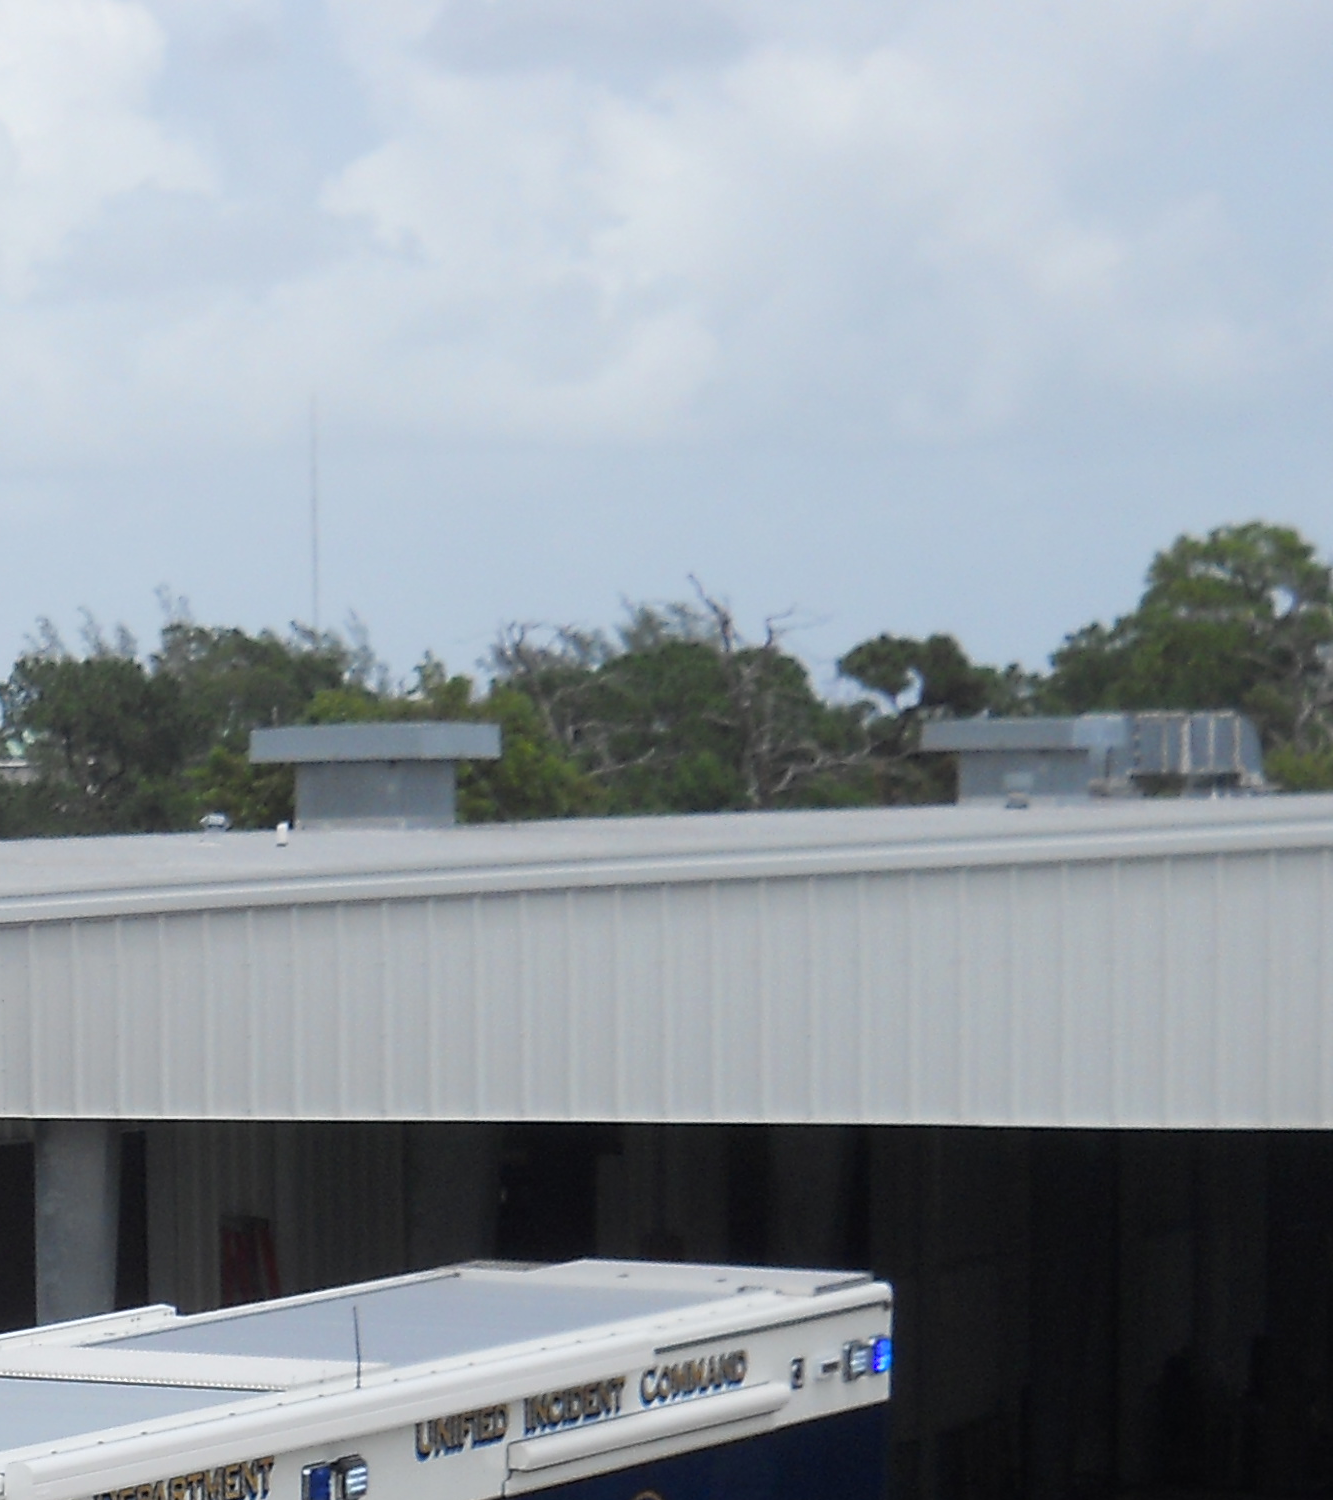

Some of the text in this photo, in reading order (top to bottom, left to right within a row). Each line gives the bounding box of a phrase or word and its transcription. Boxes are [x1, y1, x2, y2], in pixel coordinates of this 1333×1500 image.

[415, 1350, 748, 1461] UNIFIED INCIDENT COMMAND
